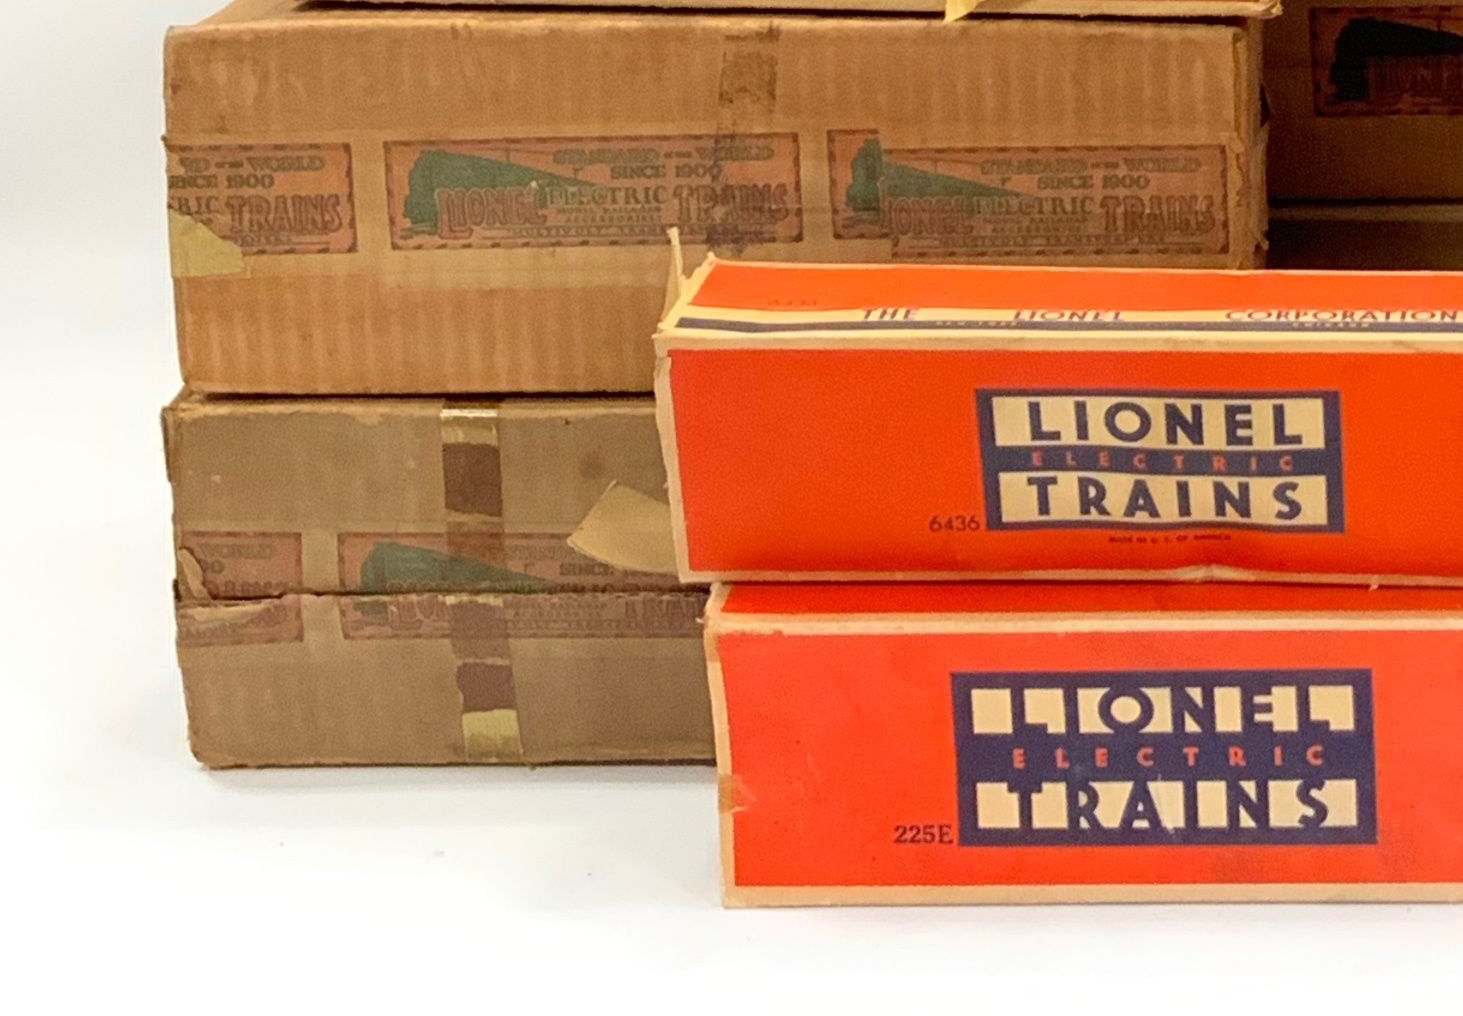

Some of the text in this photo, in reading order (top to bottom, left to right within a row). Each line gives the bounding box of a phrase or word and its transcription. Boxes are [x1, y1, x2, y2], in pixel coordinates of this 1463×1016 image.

[609, 165, 666, 180] SINCE
[225, 194, 343, 234] TRAINS
[436, 185, 667, 240] LIONEL ELECTRIC
[1101, 194, 1215, 234] TRAINS
[863, 307, 1459, 322] THE LIONEL CORPORATION
[1027, 401, 1303, 446] LIONEL
[1032, 451, 1293, 472] ELECTRIC
[1027, 477, 1302, 521] TRAINS
[929, 514, 981, 532] 6436
[1010, 686, 1332, 734] LIONEL
[1013, 746, 1323, 768] ELECTRIC
[1007, 780, 1328, 829] TRAINS
[894, 825, 953, 844] 225E
